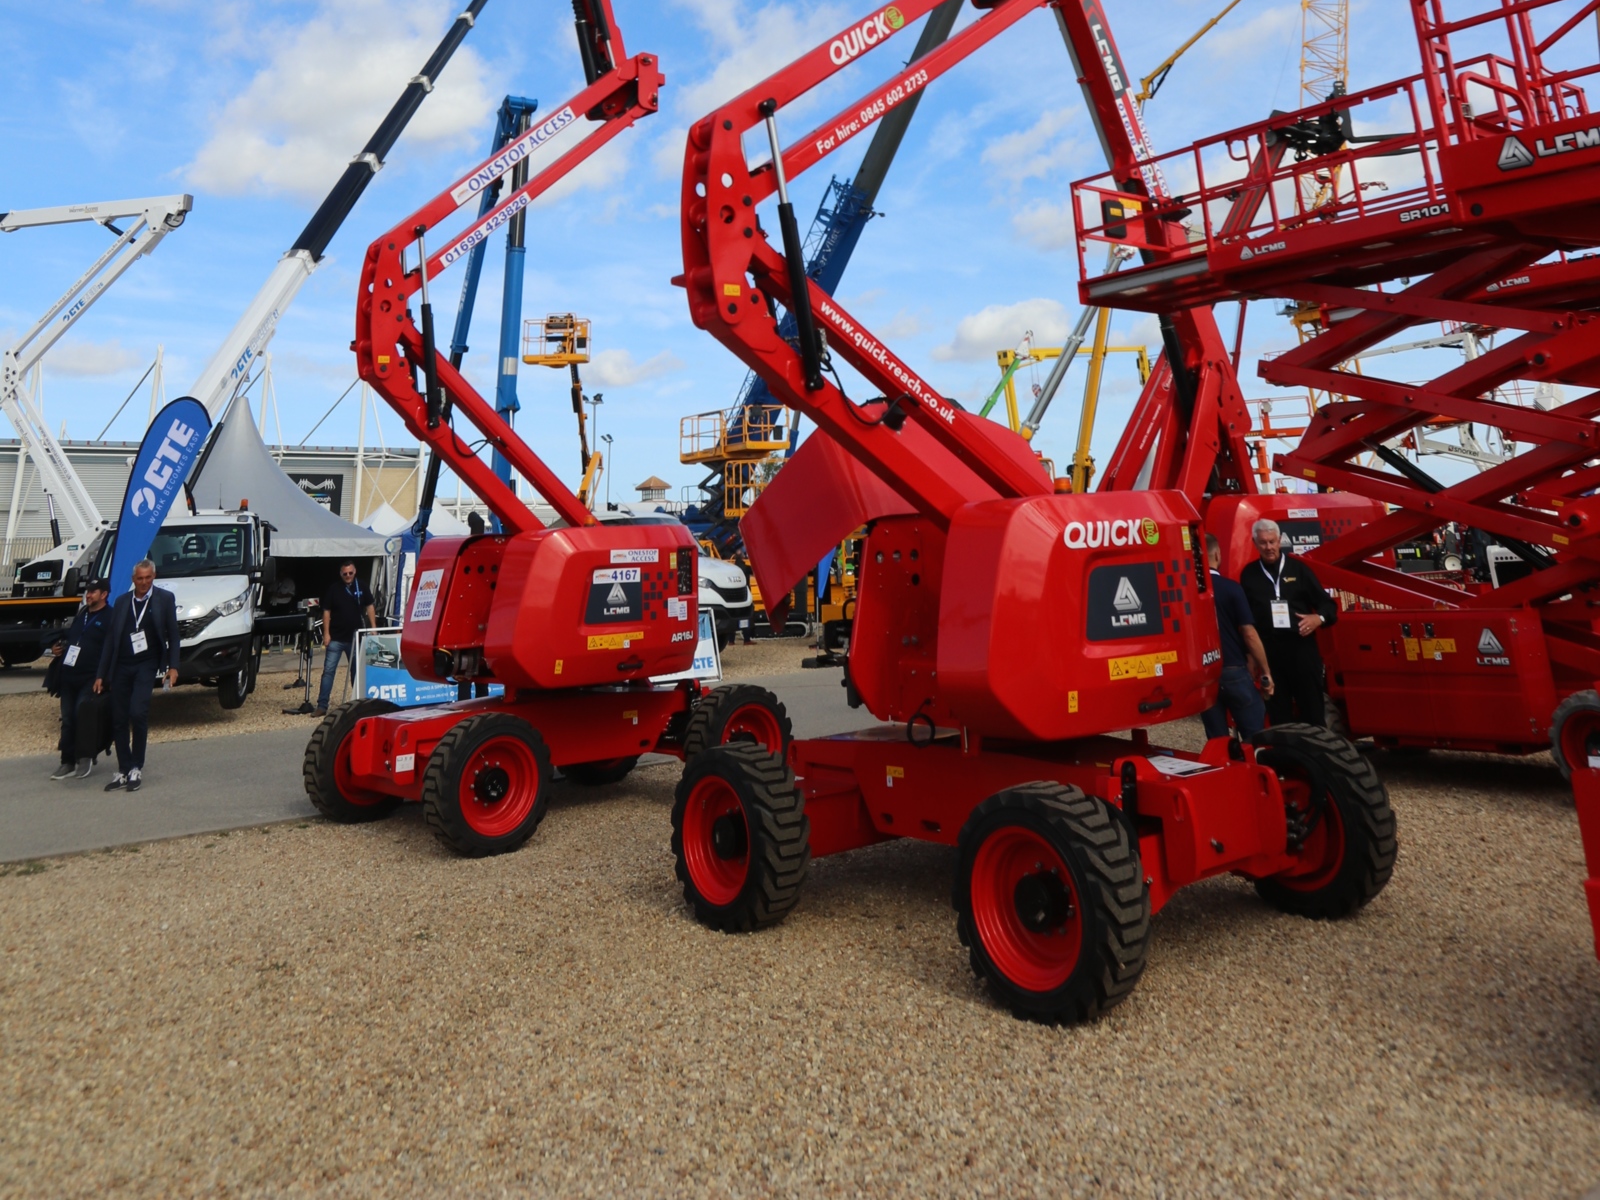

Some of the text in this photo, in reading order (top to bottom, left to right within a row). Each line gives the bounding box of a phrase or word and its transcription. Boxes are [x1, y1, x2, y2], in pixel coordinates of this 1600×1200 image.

[829, 12, 891, 66] QUICK
[816, 69, 929, 154] For hire: 0845 602 2733
[468, 109, 573, 192] ONESTOP ACCESS
[445, 195, 528, 264] 01698 423826
[69, 299, 85, 316] CTE
[236, 346, 253, 373] CTE
[820, 301, 956, 425] www.quick-reach.co.uk
[144, 418, 195, 490] CTE
[1454, 446, 1480, 457] snorkel
[149, 431, 200, 524] WORK BECOMES EASY
[1063, 519, 1142, 549] QUICK
[611, 569, 637, 581] 4167
[671, 630, 693, 643] AR16J
[693, 656, 714, 670] CTE
[380, 684, 407, 699] CTE
